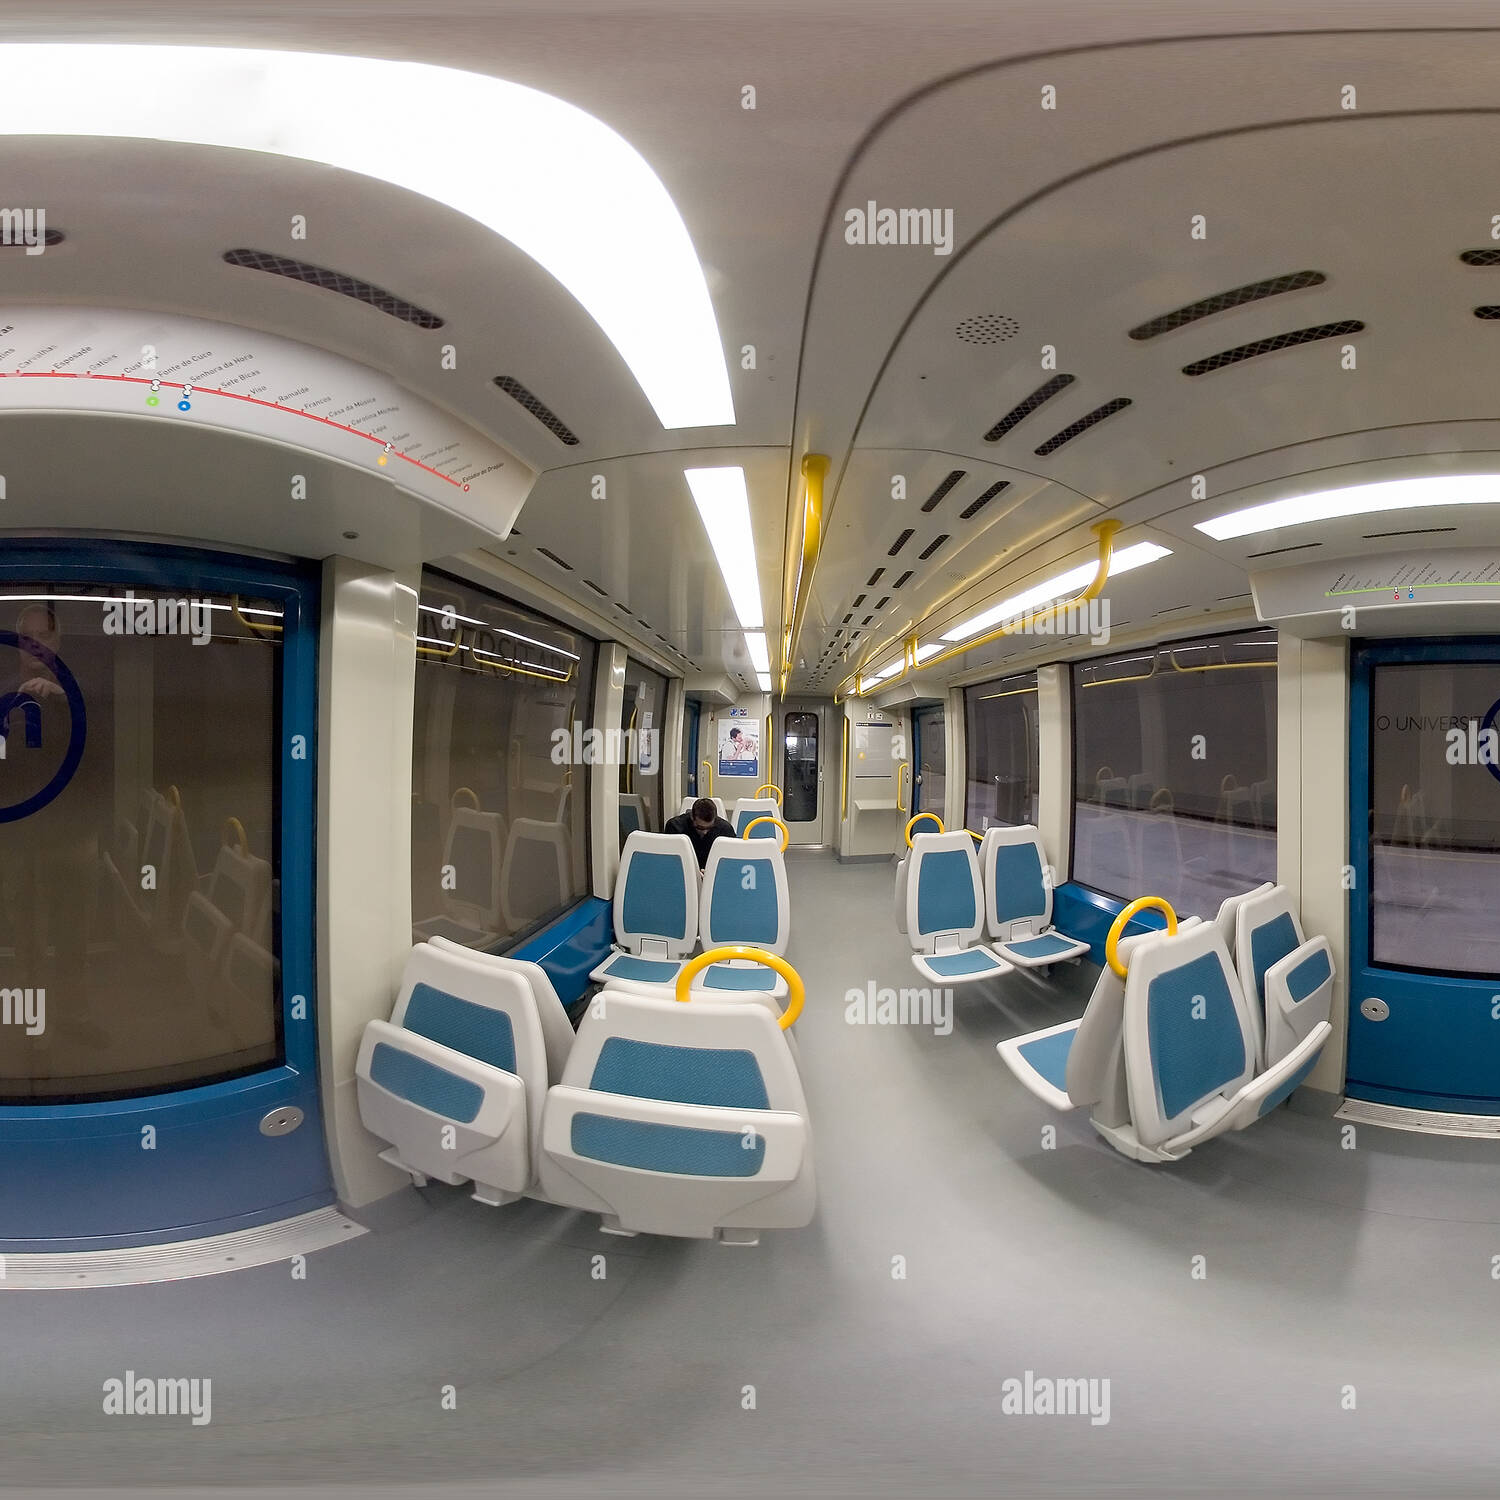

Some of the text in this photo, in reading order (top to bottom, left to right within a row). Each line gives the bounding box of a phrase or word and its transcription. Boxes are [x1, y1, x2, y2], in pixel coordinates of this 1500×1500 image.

[53, 345, 93, 370] Esposade
[156, 362, 182, 378] Fonte
[191, 350, 213, 363] Cuco
[190, 364, 223, 384] Senhora
[234, 353, 254, 365] Hora
[221, 376, 240, 389] Sete
[249, 384, 267, 396] Viso
[278, 385, 309, 402] Ramalde
